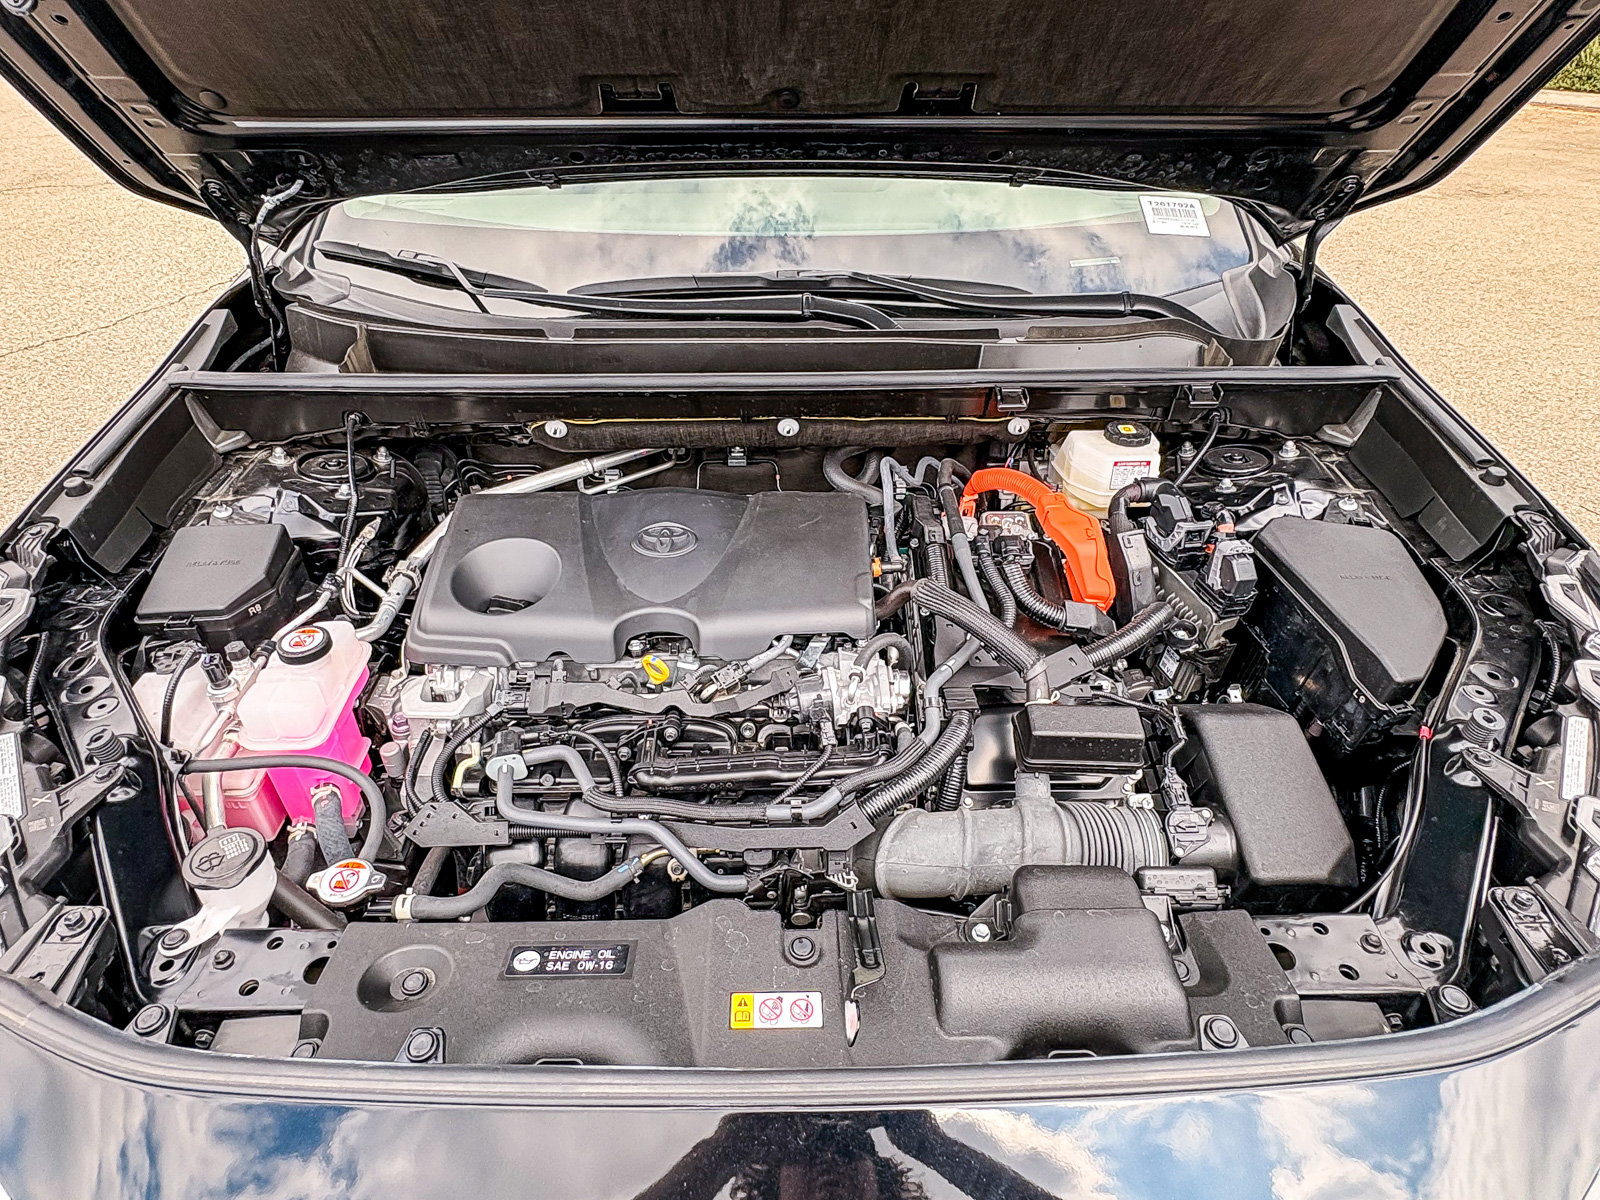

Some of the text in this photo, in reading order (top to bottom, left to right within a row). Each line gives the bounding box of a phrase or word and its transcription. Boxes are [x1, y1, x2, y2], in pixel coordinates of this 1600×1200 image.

[548, 948, 616, 959] ENGINE OIL
[546, 961, 571, 971] SAE
